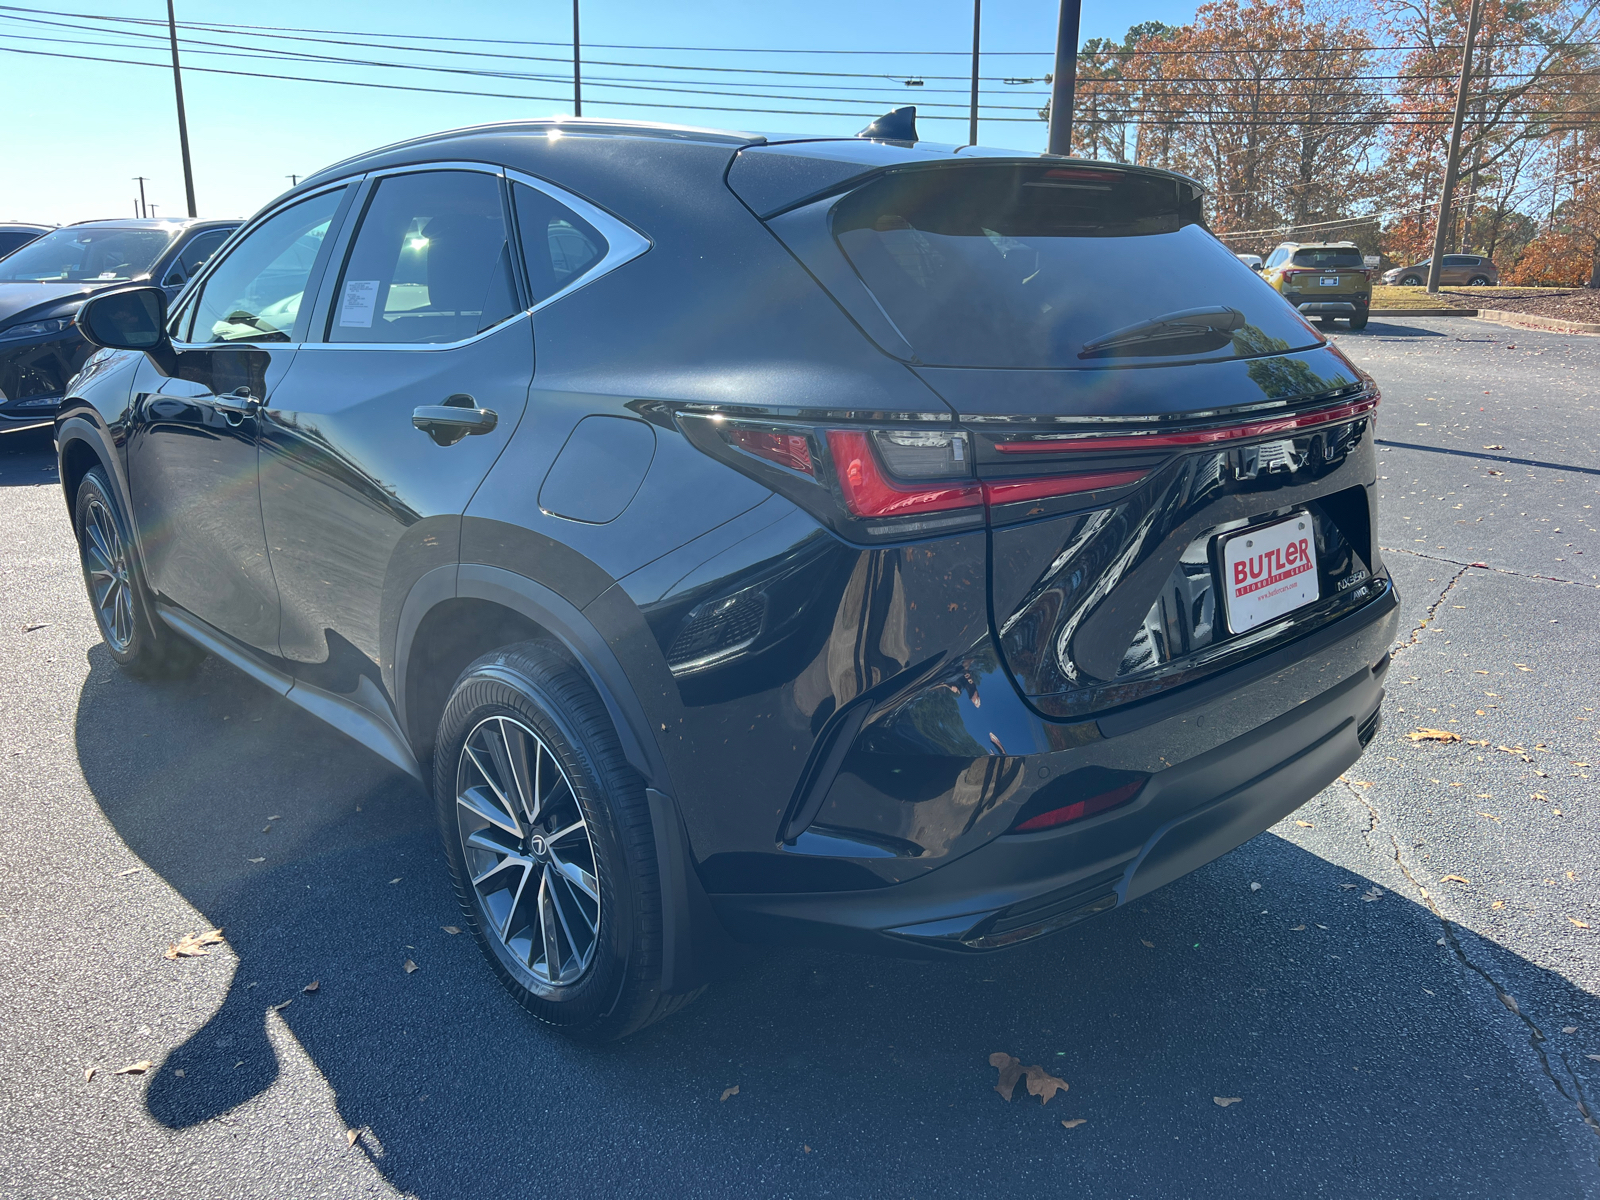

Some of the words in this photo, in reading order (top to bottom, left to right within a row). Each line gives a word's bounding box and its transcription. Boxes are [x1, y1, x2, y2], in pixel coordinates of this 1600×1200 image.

[1235, 440, 1356, 481] LEXUS
[1236, 574, 1284, 598] AUTOMOTIVE
[1290, 562, 1313, 576] GROUP
[1257, 582, 1298, 601] www.butlercars.com
[1337, 571, 1366, 591] NX350
